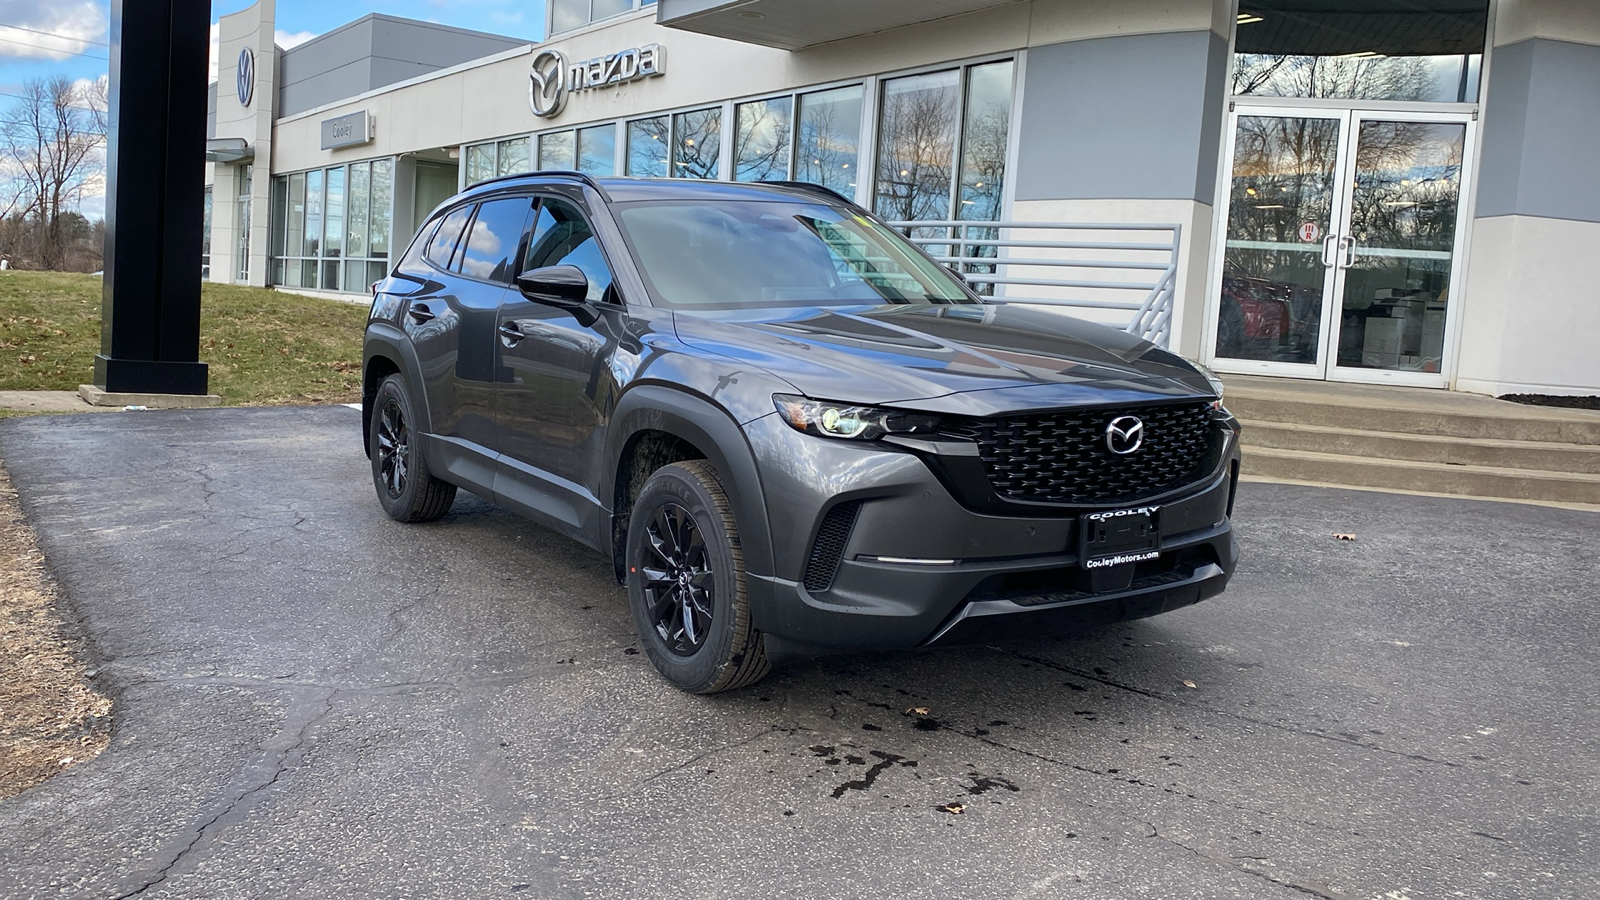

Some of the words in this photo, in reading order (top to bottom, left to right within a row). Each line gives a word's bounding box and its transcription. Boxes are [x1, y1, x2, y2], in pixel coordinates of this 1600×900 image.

[332, 119, 353, 140] Cooley
[1089, 506, 1160, 520] COOLEY
[1086, 551, 1159, 569] CooleyMotors.com
